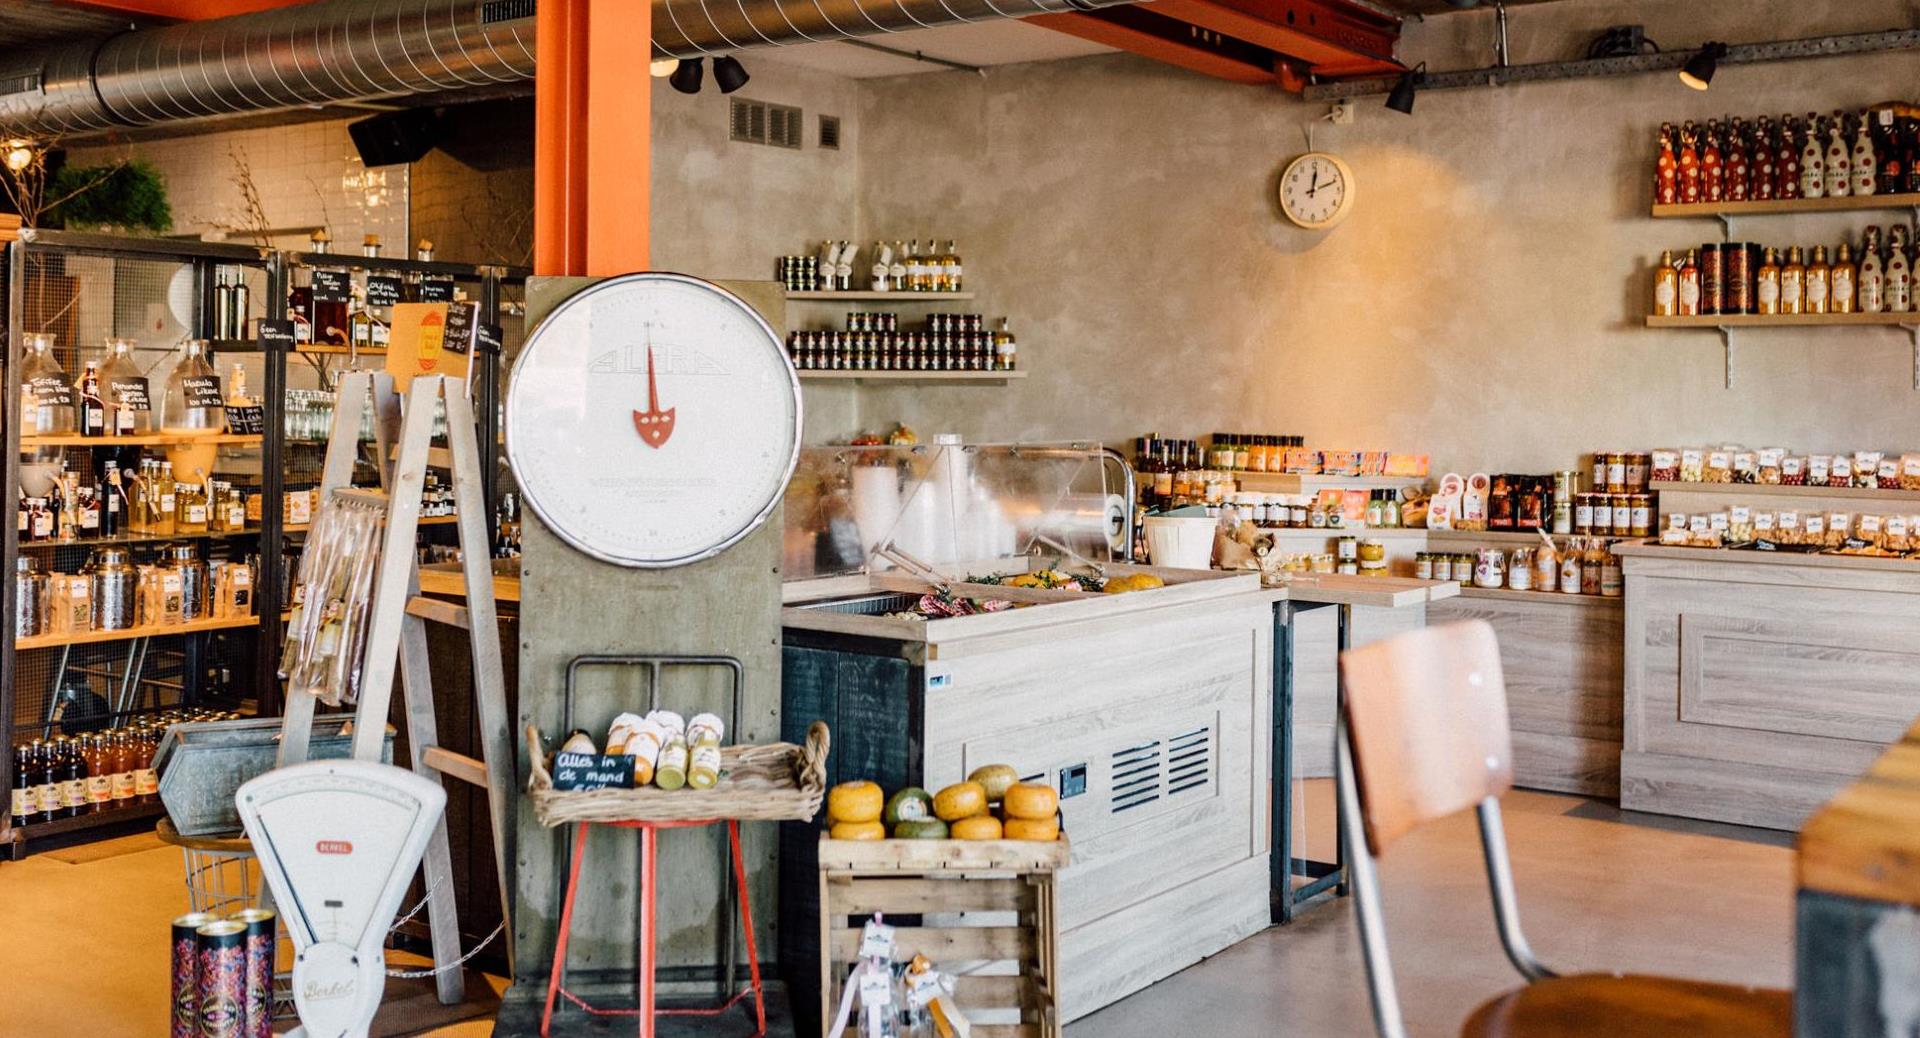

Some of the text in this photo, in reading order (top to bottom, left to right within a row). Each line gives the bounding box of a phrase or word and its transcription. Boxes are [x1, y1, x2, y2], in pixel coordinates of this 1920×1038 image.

[601, 755, 616, 768] in
[558, 768, 625, 784] de mand
